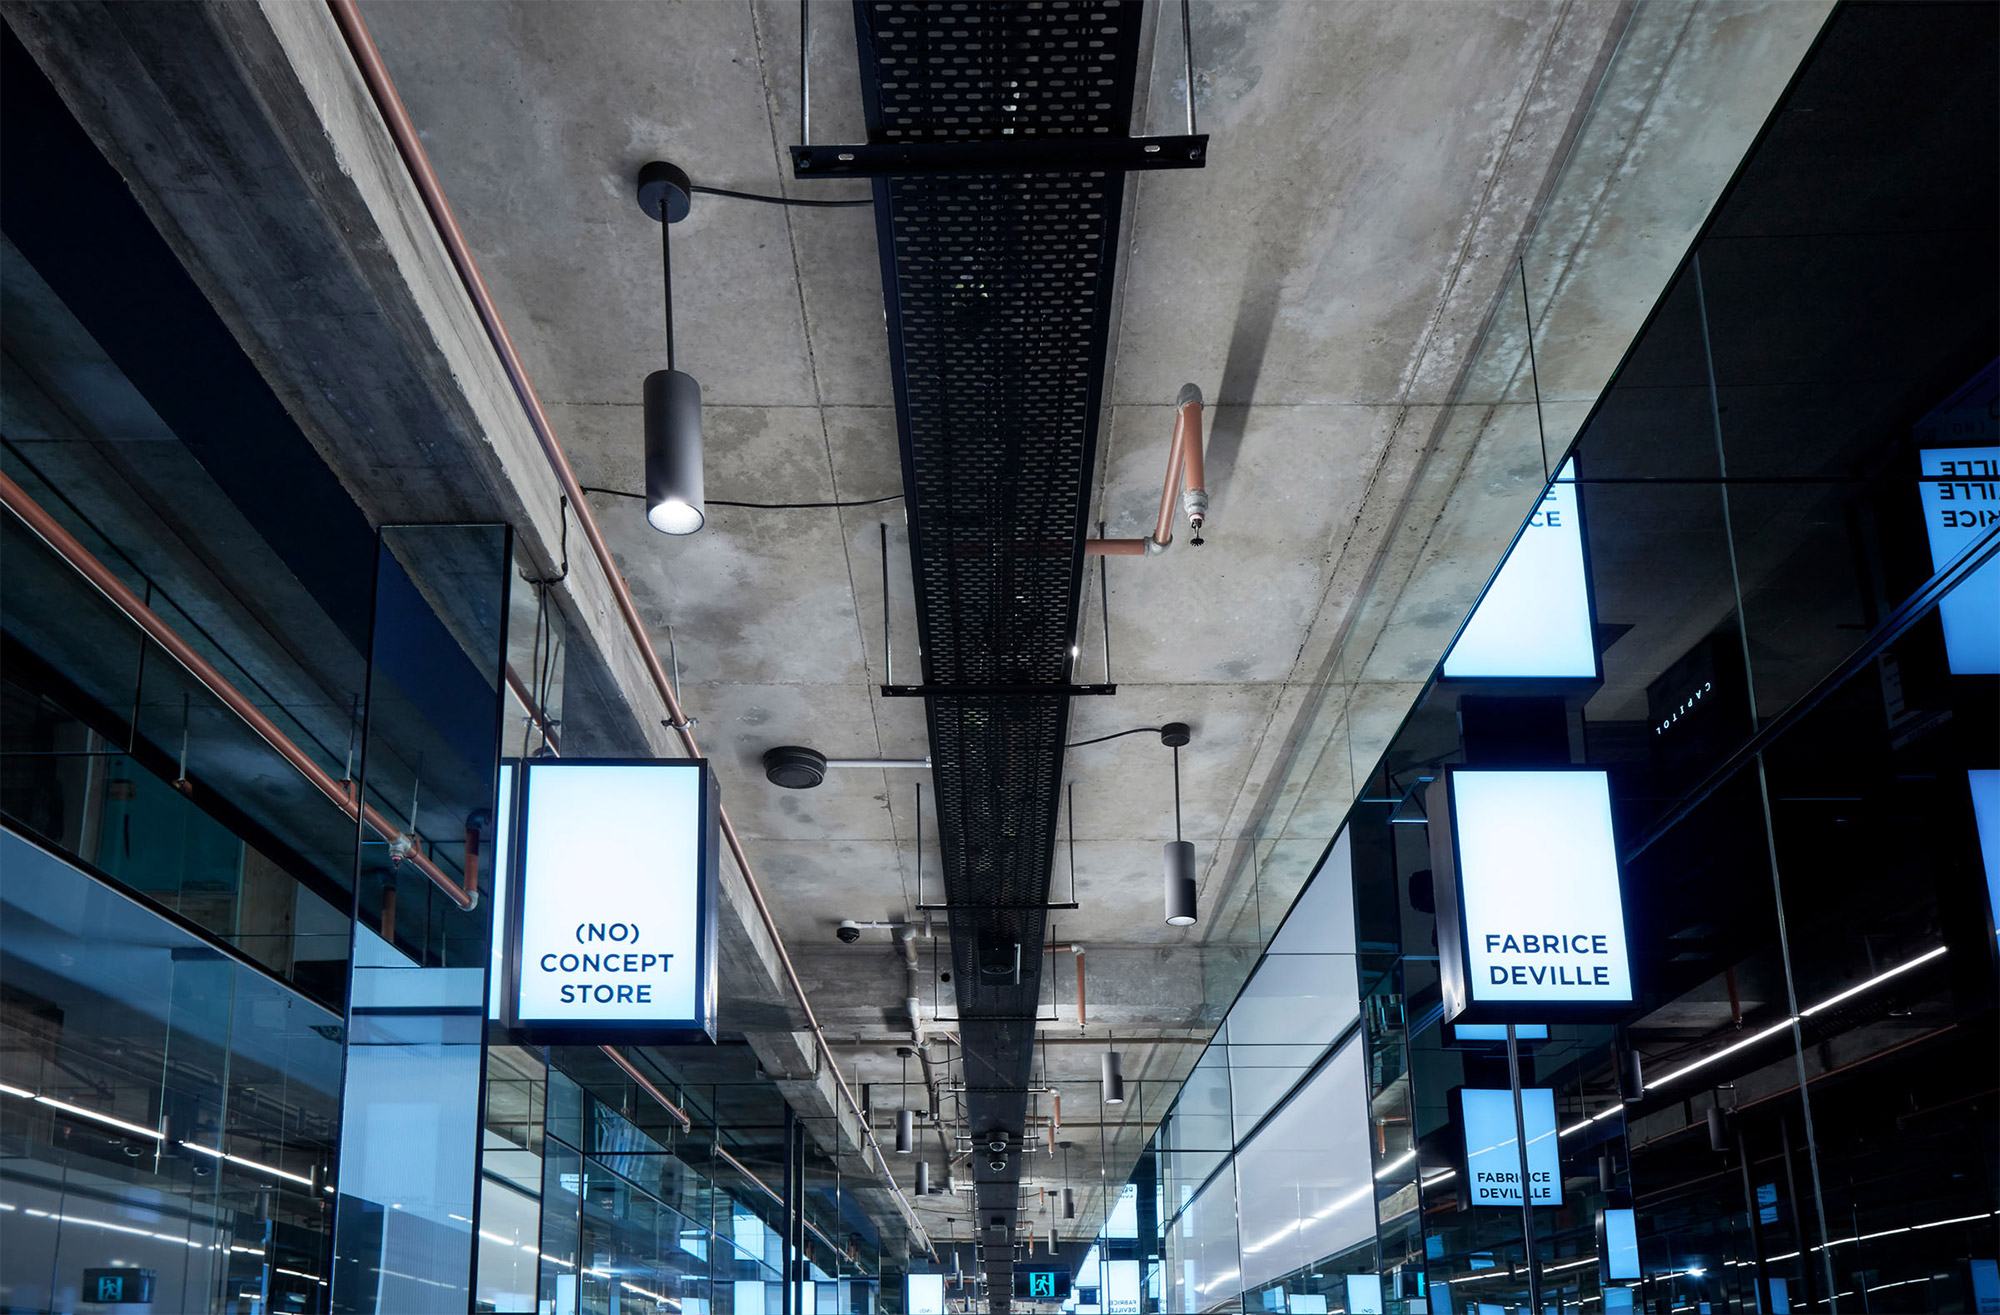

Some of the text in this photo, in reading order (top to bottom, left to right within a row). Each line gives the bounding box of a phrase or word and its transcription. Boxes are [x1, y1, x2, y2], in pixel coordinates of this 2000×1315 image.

[575, 922, 640, 945] (NO)
[1485, 934, 1609, 955] FABRICE
[540, 953, 675, 973] CONCEPT
[1489, 965, 1611, 986] DEVILLE
[560, 984, 652, 1004] STORE
